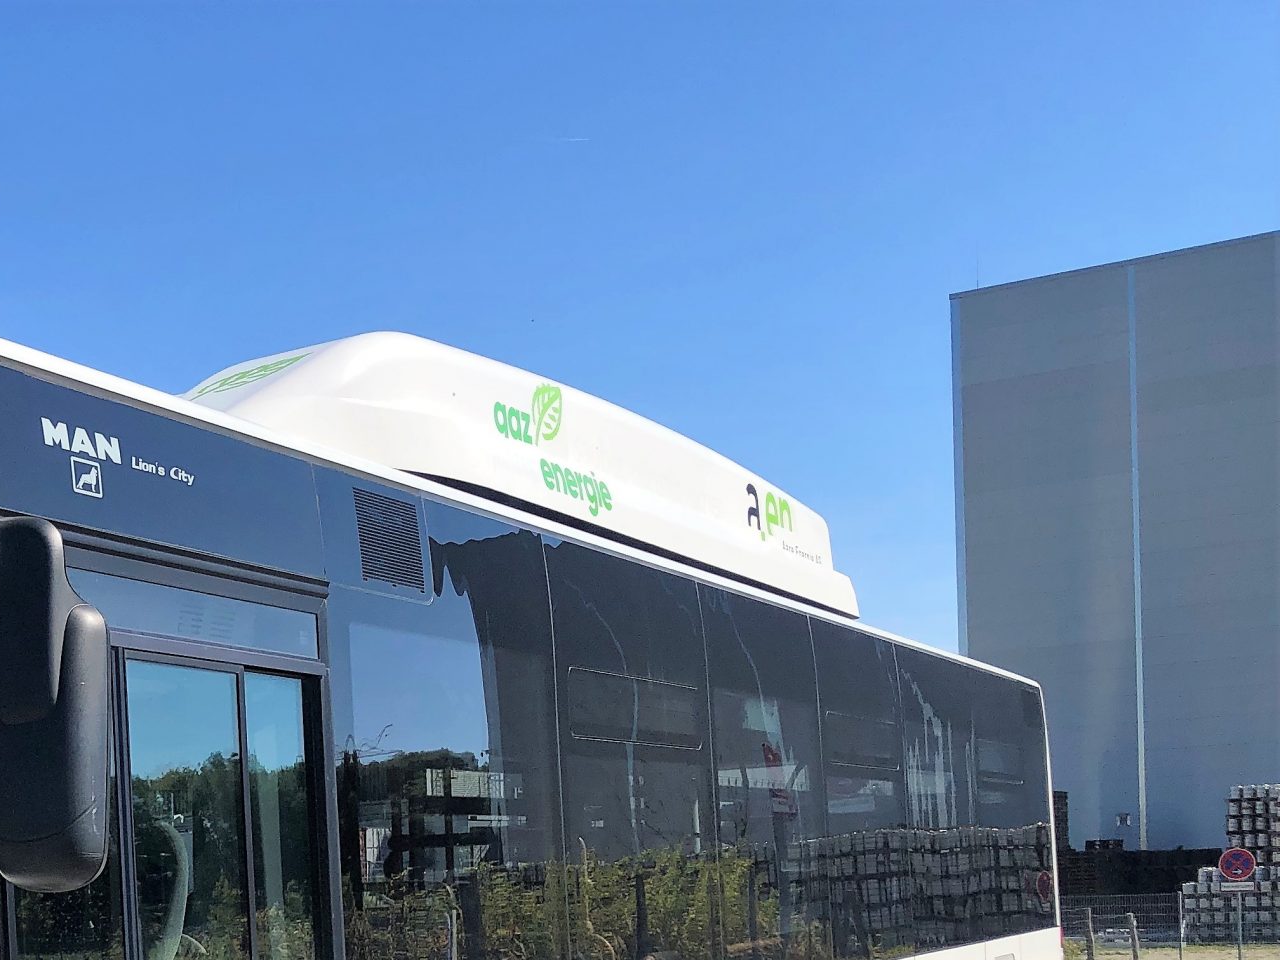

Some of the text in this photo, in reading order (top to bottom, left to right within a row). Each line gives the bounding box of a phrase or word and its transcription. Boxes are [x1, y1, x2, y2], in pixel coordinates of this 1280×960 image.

[40, 416, 195, 487] MAN Lion's City
[540, 458, 613, 517] energie
